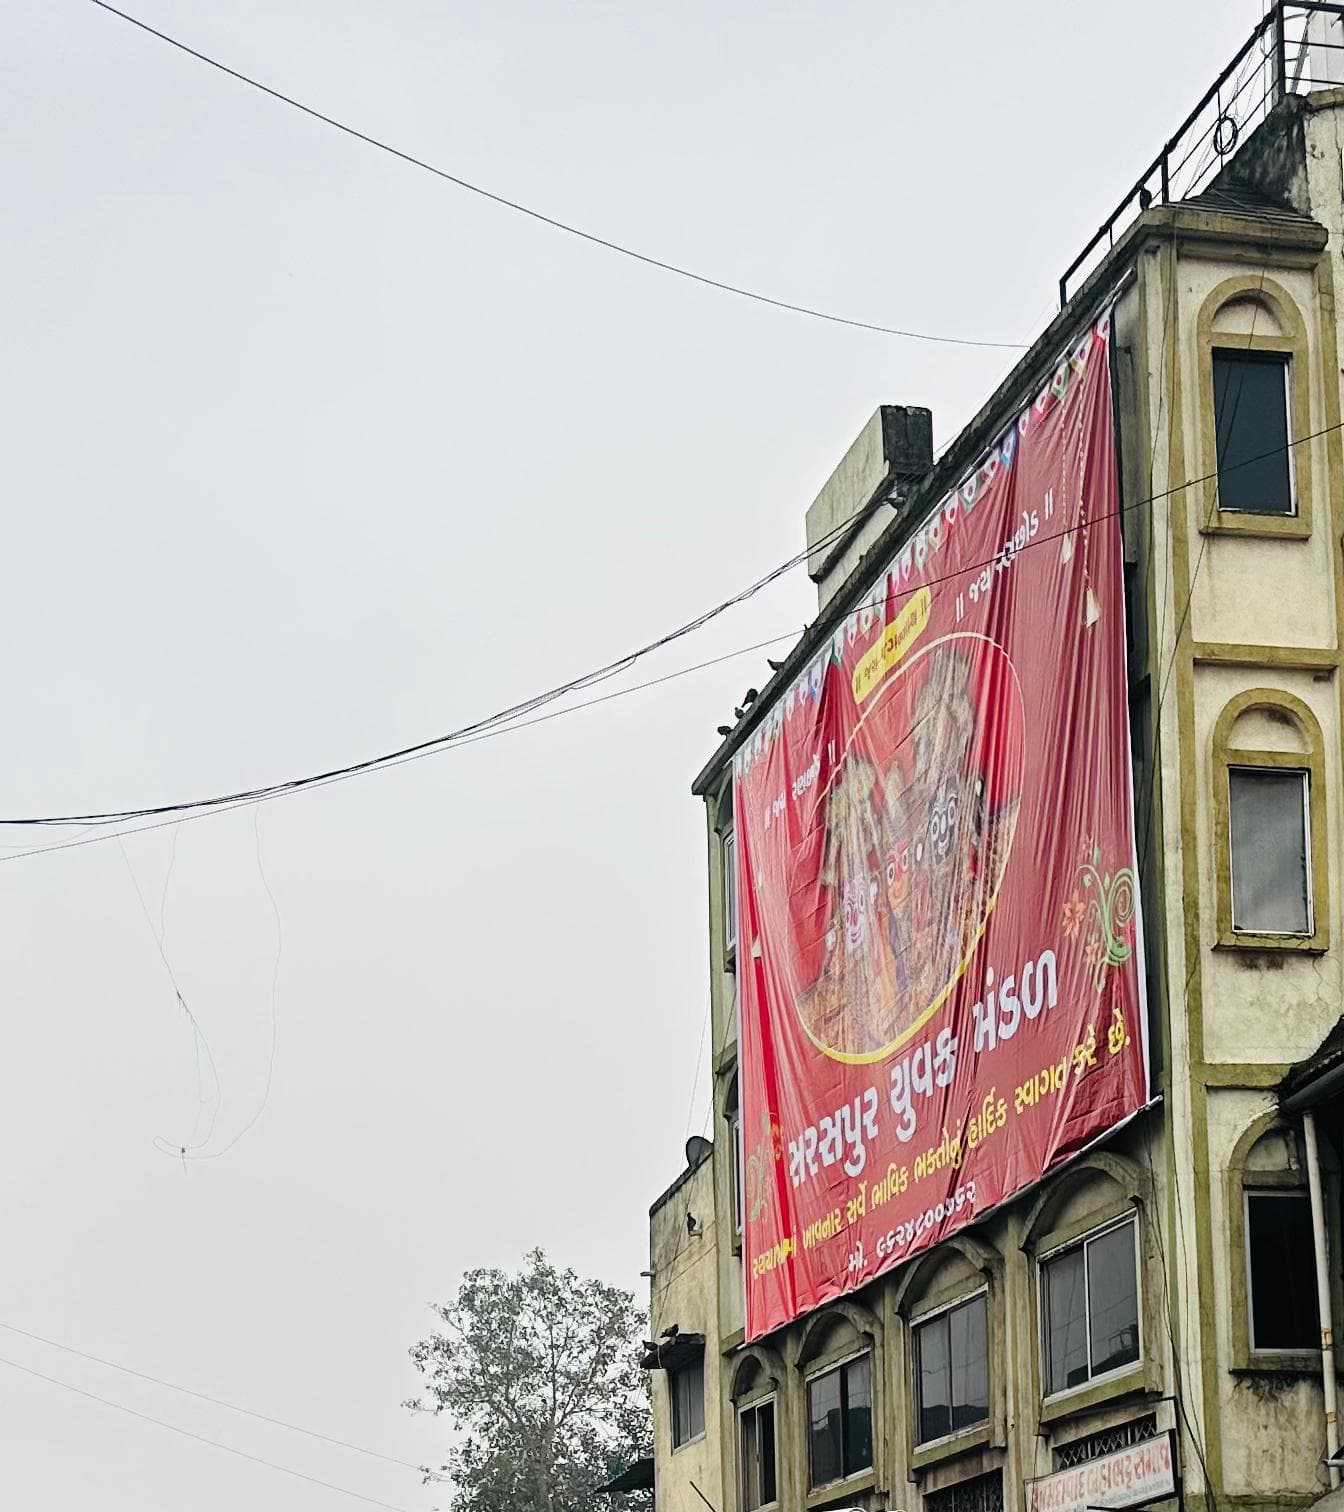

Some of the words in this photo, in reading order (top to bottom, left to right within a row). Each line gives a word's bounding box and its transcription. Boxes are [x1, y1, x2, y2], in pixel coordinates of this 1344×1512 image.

[788, 1086, 879, 1189] સરસપુર
[890, 1026, 958, 1144] યુવક
[971, 947, 1058, 1054] મંડળ
